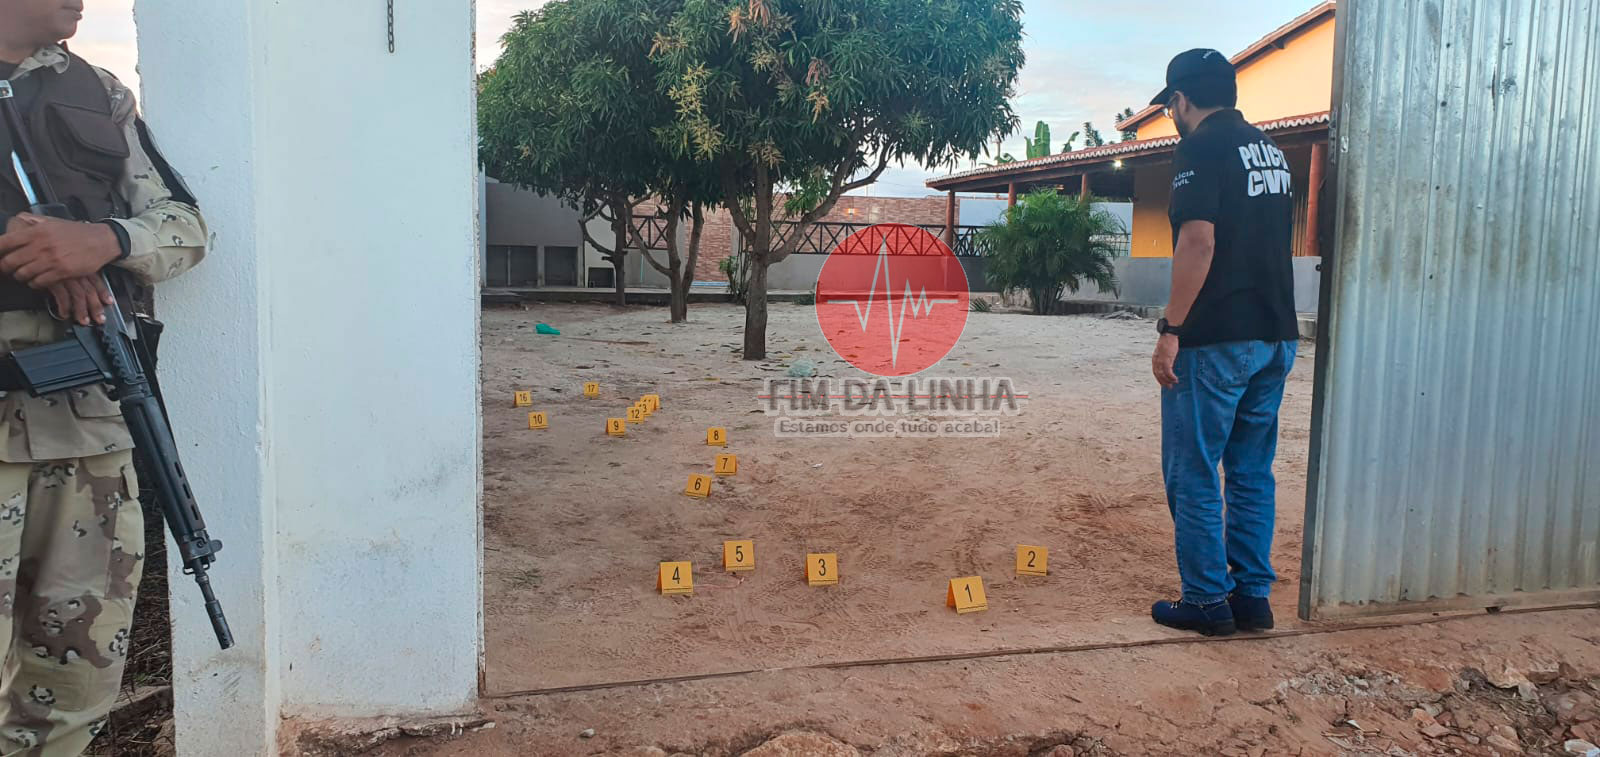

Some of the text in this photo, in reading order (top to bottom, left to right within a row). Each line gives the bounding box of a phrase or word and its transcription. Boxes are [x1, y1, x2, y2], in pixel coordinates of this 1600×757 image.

[1247, 169, 1293, 197] CIVI
[533, 414, 543, 425] 10
[631, 409, 640, 419] 12
[613, 420, 619, 431] 9
[713, 430, 719, 441] 8
[722, 457, 729, 470] 7
[694, 477, 702, 491] 6
[735, 545, 744, 563] 5
[1027, 550, 1036, 568] 2
[672, 566, 681, 585] 4
[818, 558, 827, 577] 3
[965, 583, 973, 603] 1
